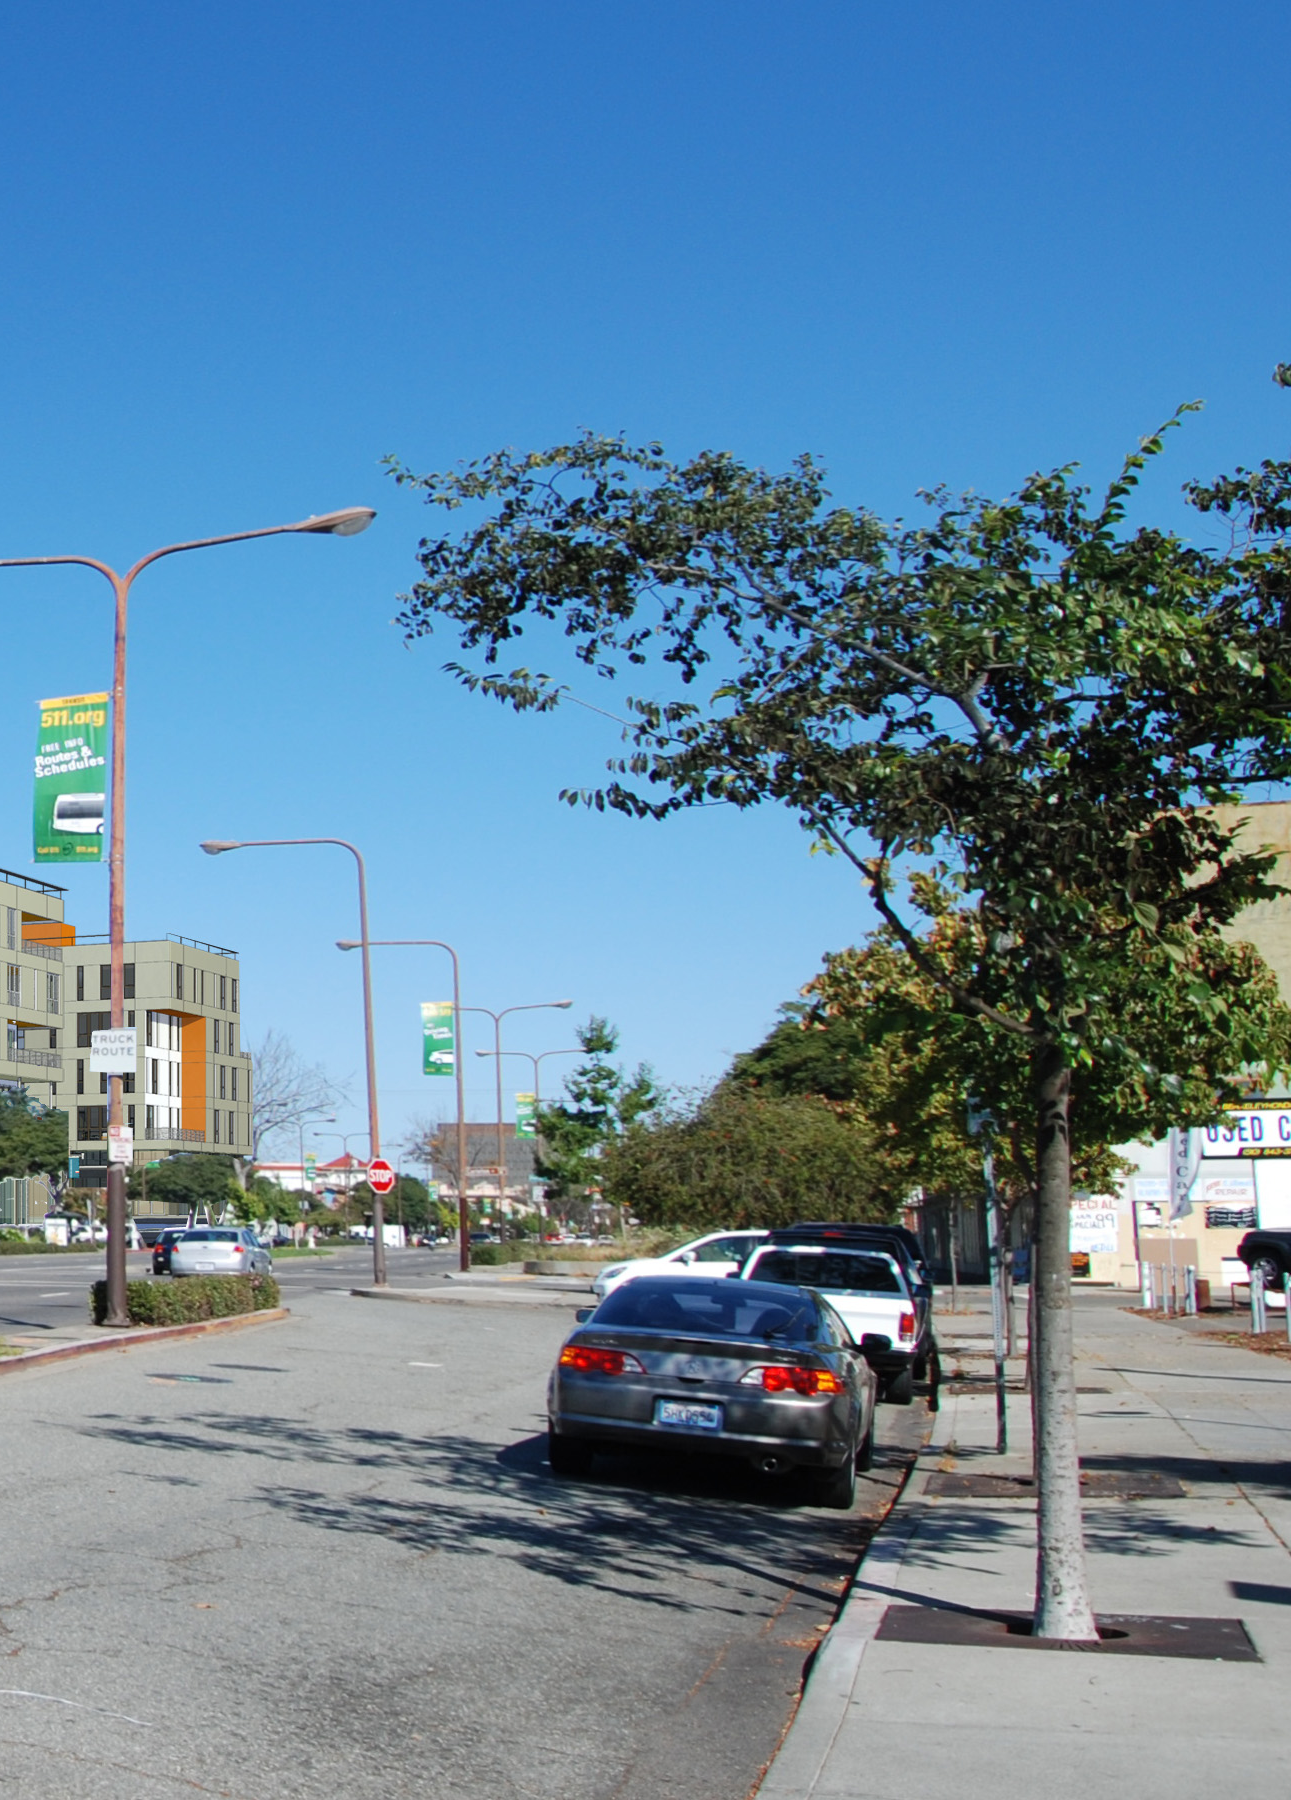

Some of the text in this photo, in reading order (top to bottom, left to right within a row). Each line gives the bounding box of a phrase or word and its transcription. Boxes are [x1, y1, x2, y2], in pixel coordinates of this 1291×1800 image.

[41, 709, 106, 728] 511.org
[35, 745, 93, 768] Routes &
[34, 756, 105, 778] Schedules
[92, 1034, 134, 1044] TRUCK
[92, 1046, 135, 1057] ROUTE
[1206, 1115, 1264, 1143] USED
[369, 1169, 392, 1183] STOP
[1069, 1200, 1117, 1211] PECIAL
